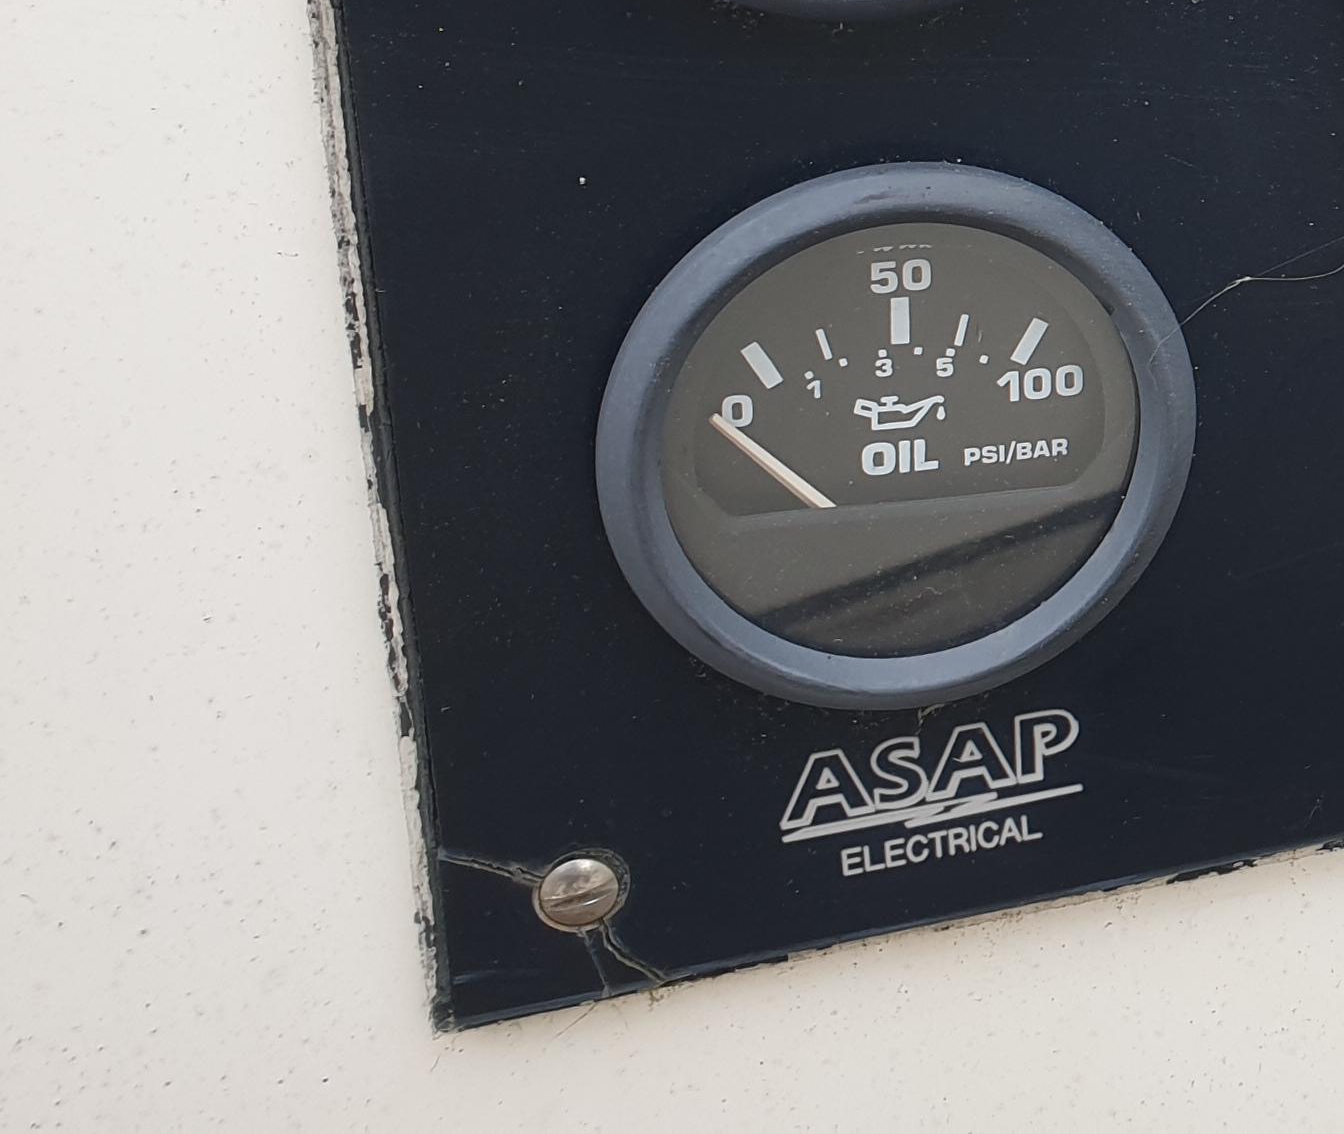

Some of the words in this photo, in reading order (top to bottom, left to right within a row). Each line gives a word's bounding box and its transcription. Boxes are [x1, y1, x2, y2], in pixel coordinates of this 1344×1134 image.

[870, 258, 933, 294] 50
[875, 357, 894, 378] 3
[935, 357, 955, 378] 5
[996, 364, 1084, 402] 100
[806, 379, 822, 399] 1
[720, 394, 754, 429] 0
[860, 439, 939, 476] OIL
[963, 438, 1069, 467] PSI/BAR
[779, 708, 1081, 831] ASAP
[839, 814, 1044, 877] ELECTRICAL
